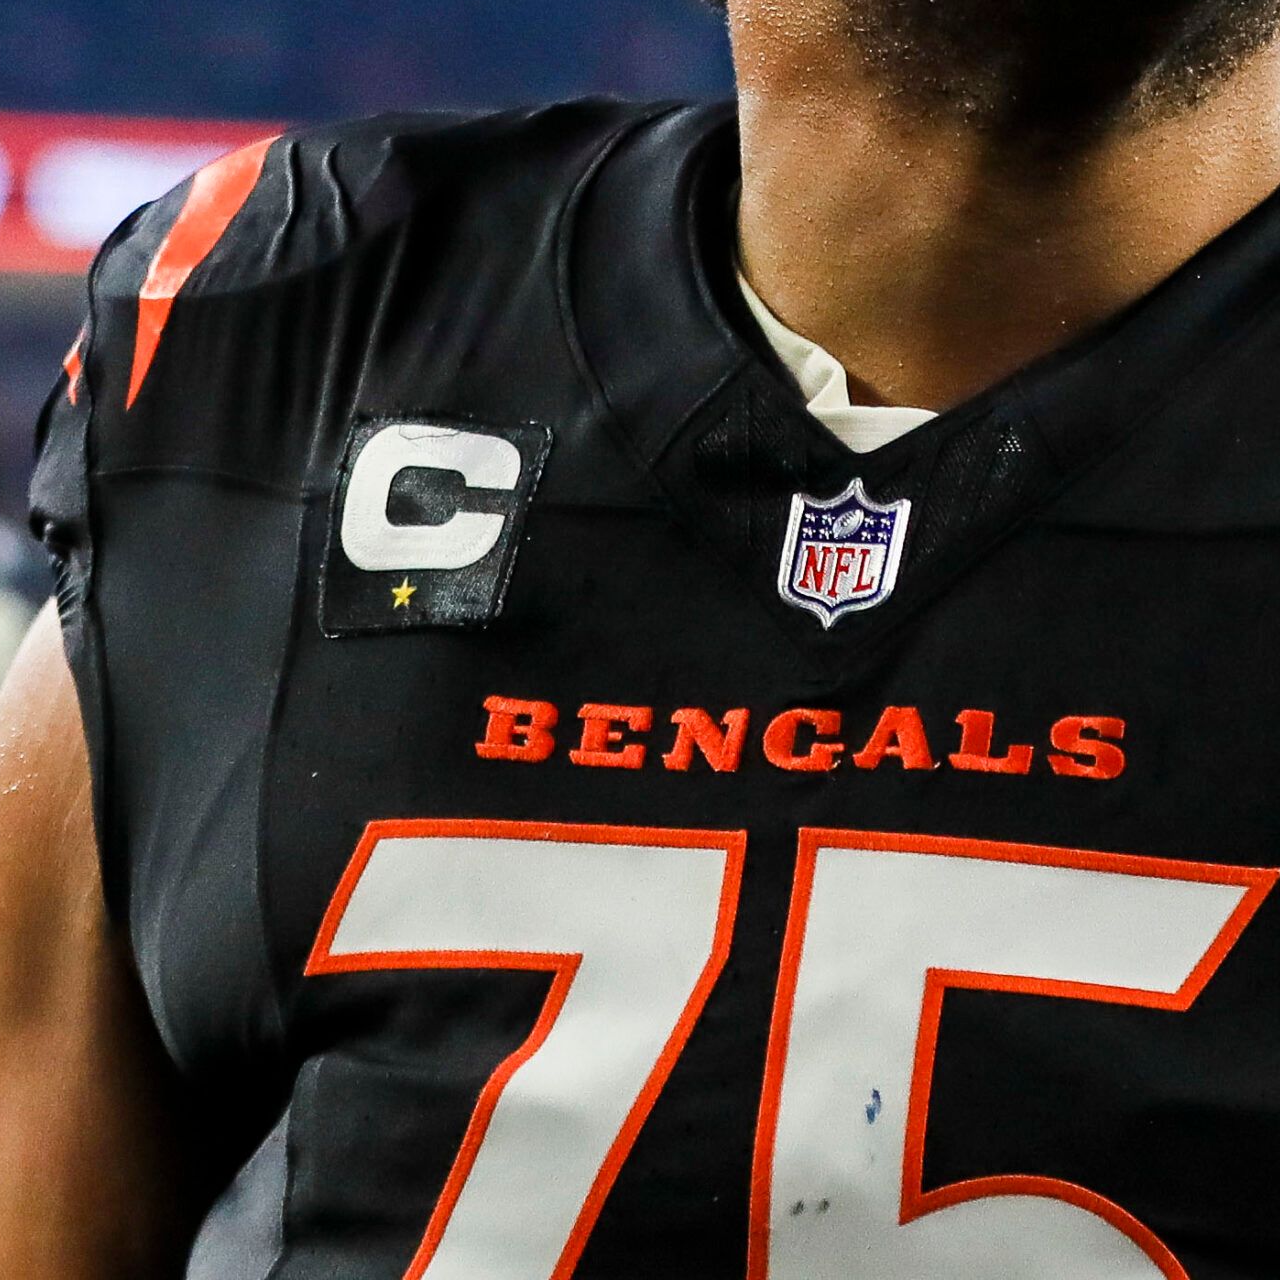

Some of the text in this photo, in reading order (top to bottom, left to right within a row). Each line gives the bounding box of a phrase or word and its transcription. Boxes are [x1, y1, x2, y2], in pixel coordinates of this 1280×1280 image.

[338, 422, 521, 572] C
[798, 545, 874, 599] NFL
[474, 694, 1128, 781] BENGALS
